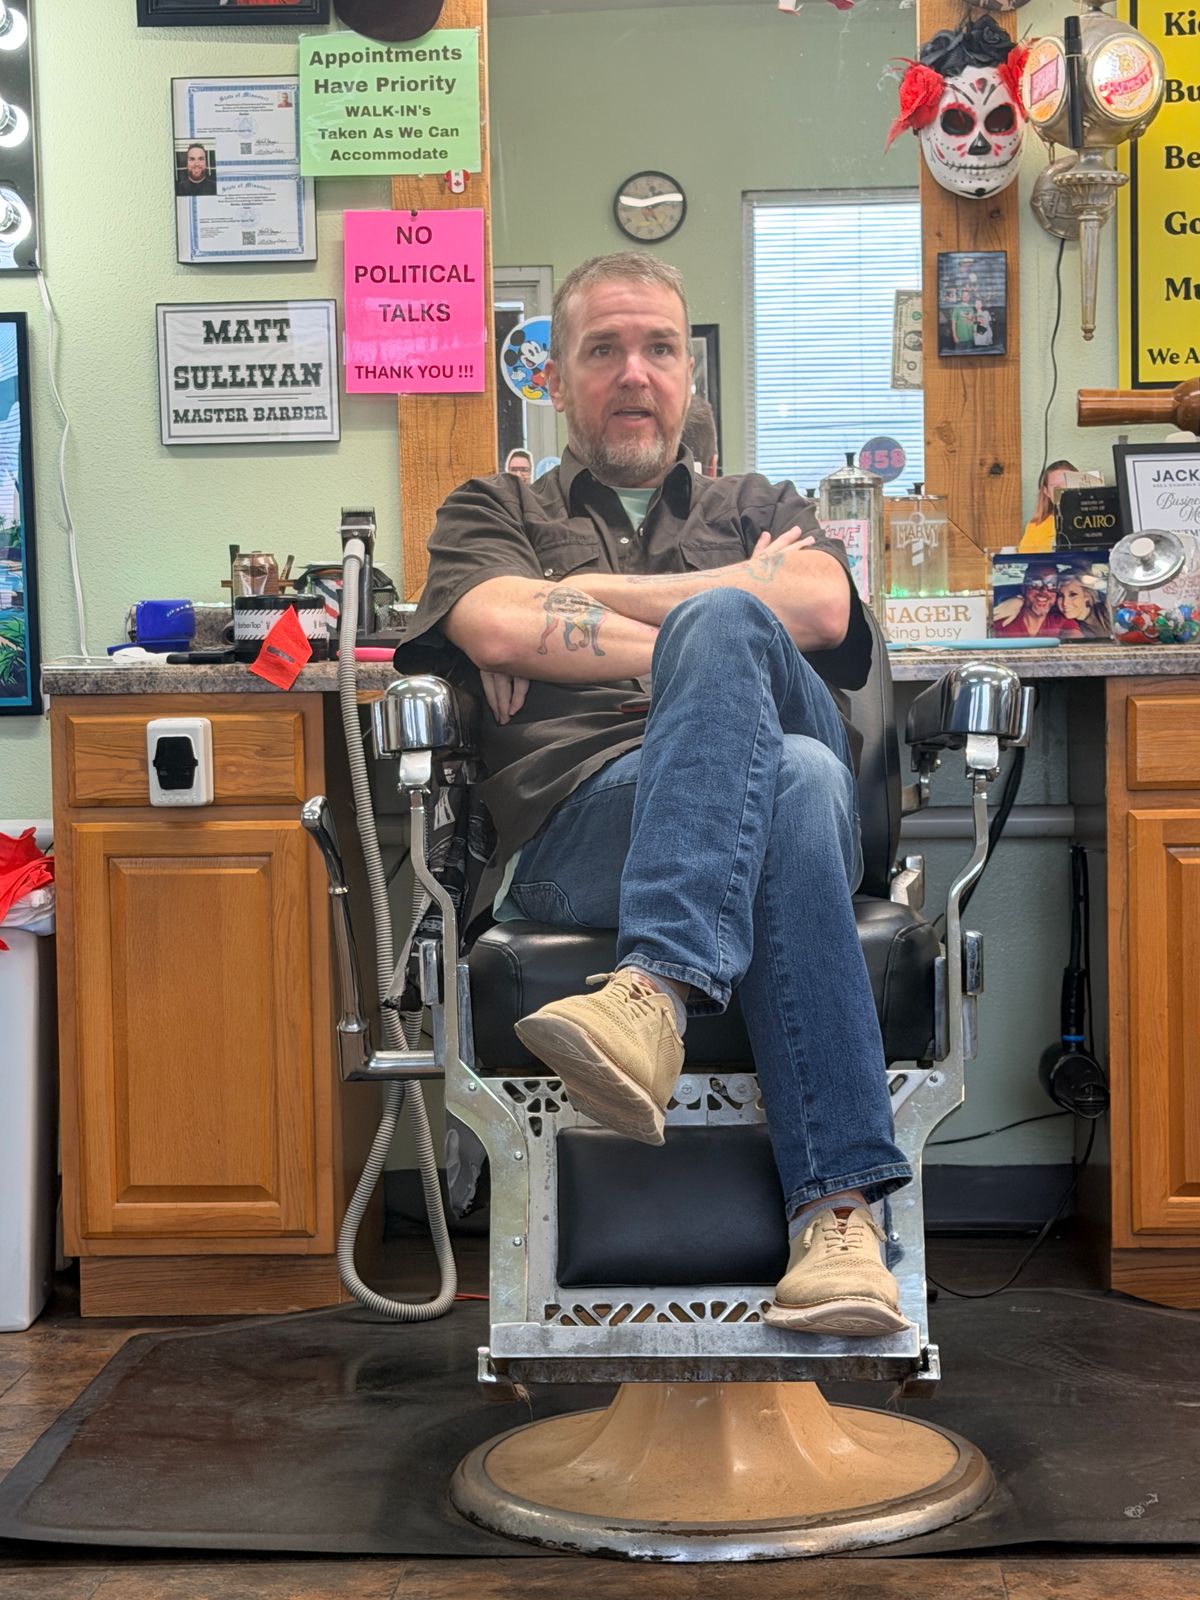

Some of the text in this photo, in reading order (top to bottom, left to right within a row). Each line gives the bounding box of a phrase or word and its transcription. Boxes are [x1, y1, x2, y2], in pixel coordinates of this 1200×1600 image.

[1164, 10, 1200, 36] Ki
[309, 45, 462, 69] Appointments
[314, 75, 456, 95] Have Priority
[345, 104, 431, 117] WALK-IN's
[318, 126, 459, 140] Taken As We Can
[330, 147, 448, 161] Accommodate
[396, 226, 433, 245] NO
[354, 264, 475, 284] POLITICAL
[378, 303, 451, 322] TALKS
[202, 318, 290, 345] MATT
[1147, 348, 1180, 365] We
[173, 362, 323, 391] SULLIVAN
[354, 365, 474, 379] THANK YOU !!!
[173, 405, 328, 424] MASTER BARBER
[1073, 514, 1116, 529] CAIRO
[926, 625, 962, 640] busy
